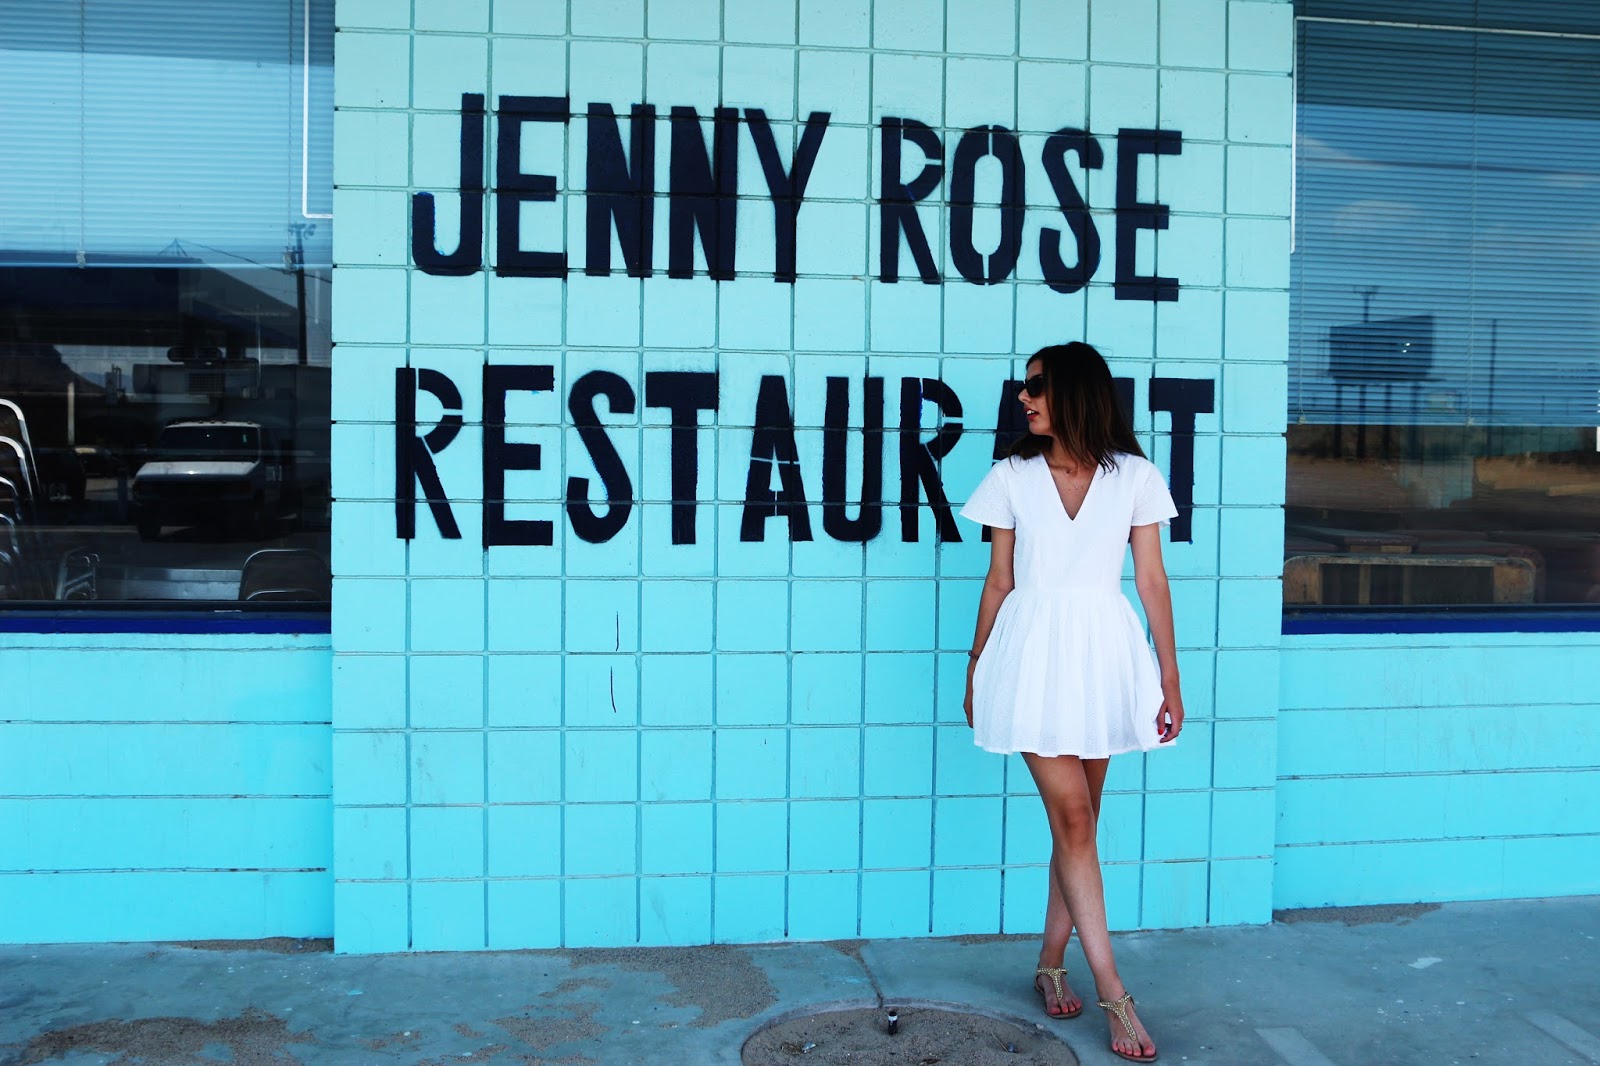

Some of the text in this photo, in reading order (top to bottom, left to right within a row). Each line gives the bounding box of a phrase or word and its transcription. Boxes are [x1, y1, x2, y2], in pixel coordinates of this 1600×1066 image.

[413, 93, 1183, 302] JENNY ROSE
[396, 364, 1215, 547] RESTAURT
